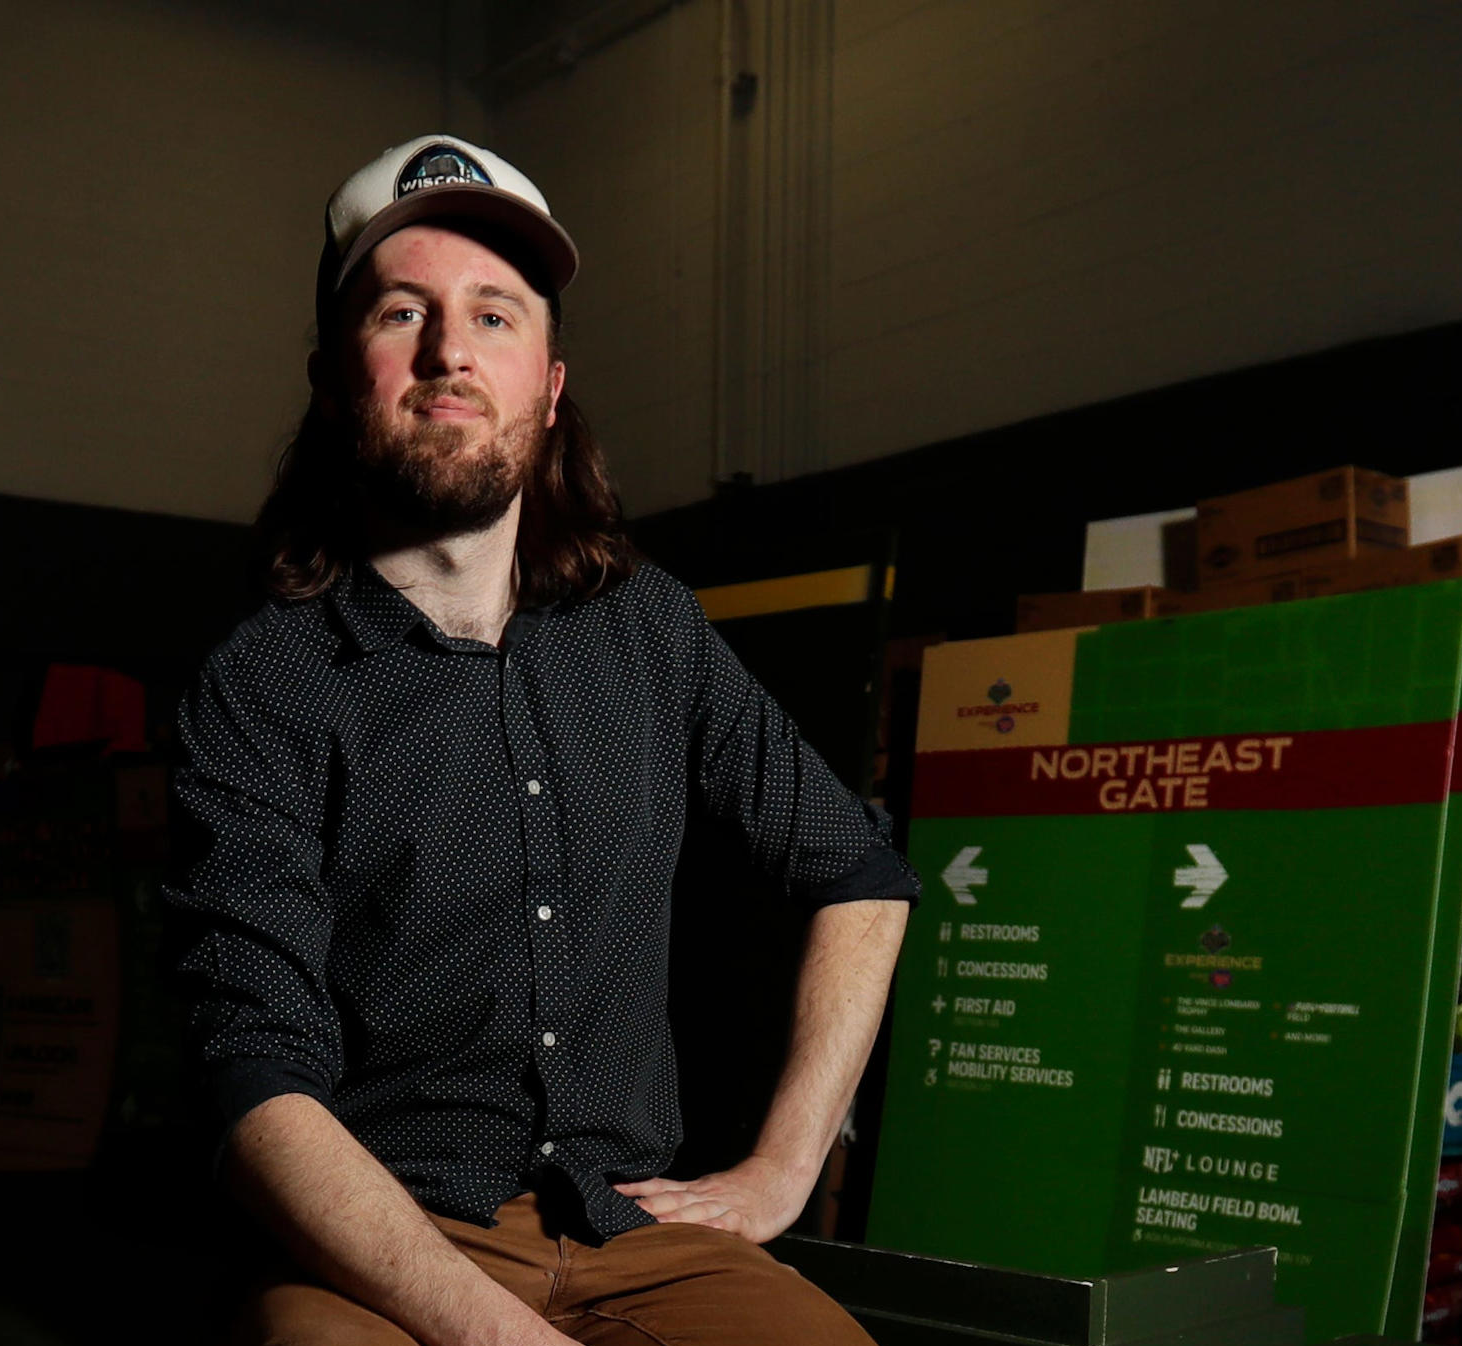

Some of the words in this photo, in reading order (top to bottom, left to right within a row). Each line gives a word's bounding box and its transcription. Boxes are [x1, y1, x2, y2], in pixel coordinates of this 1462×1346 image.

[957, 701, 1040, 718] EXPERIENCE
[1030, 736, 1294, 781] NORTHEAST
[1097, 775, 1211, 811] GATE
[960, 922, 1041, 943] RESTROOMS
[955, 960, 1049, 981] CONCESSIONS
[1164, 952, 1264, 971] EXPERIENCE
[953, 996, 990, 1015] FIRST
[991, 998, 1017, 1018] AID
[948, 1041, 978, 1061] FAN
[977, 1044, 1042, 1066] SERVICES
[947, 1061, 1008, 1081] MOBILITY
[1010, 1065, 1075, 1088] SERVICES
[1180, 1071, 1275, 1098] RESTROOMS
[1176, 1109, 1284, 1139] CONCESSIONS
[1185, 1153, 1280, 1183] LOUNGE
[1135, 1206, 1198, 1232] SEATING
[1138, 1186, 1211, 1213] LAMBEAU
[1211, 1195, 1255, 1220] FIELD
[1256, 1201, 1302, 1226] BOWL
